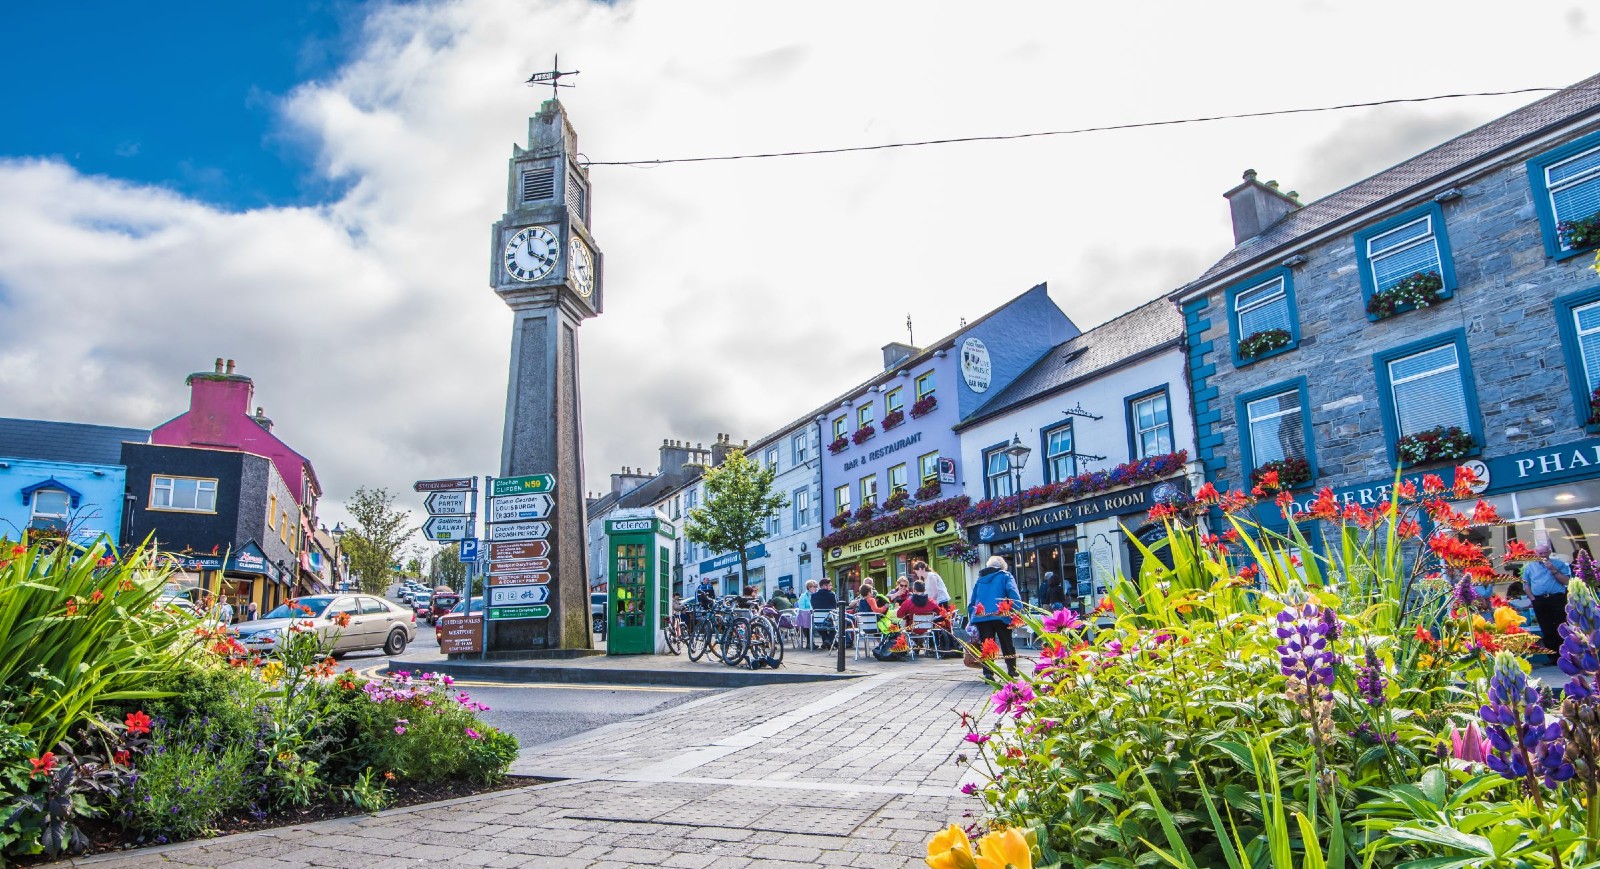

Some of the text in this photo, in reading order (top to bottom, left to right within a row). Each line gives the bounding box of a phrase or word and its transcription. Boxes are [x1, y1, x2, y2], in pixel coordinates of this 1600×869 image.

[844, 432, 922, 472] BAR & RESTAURANT
[495, 485, 522, 493] CLIFDEN
[524, 480, 541, 488] N59
[495, 503, 536, 512] LOUISBURGH
[1042, 504, 1073, 525] CAFÉ
[1076, 502, 1100, 517] TEA
[1104, 491, 1145, 511] ROOM
[494, 531, 517, 539] CROAGH
[848, 542, 862, 553] THE
[864, 535, 890, 549] CLOCK
[892, 526, 926, 543] TAVERN
[462, 540, 476, 555] P
